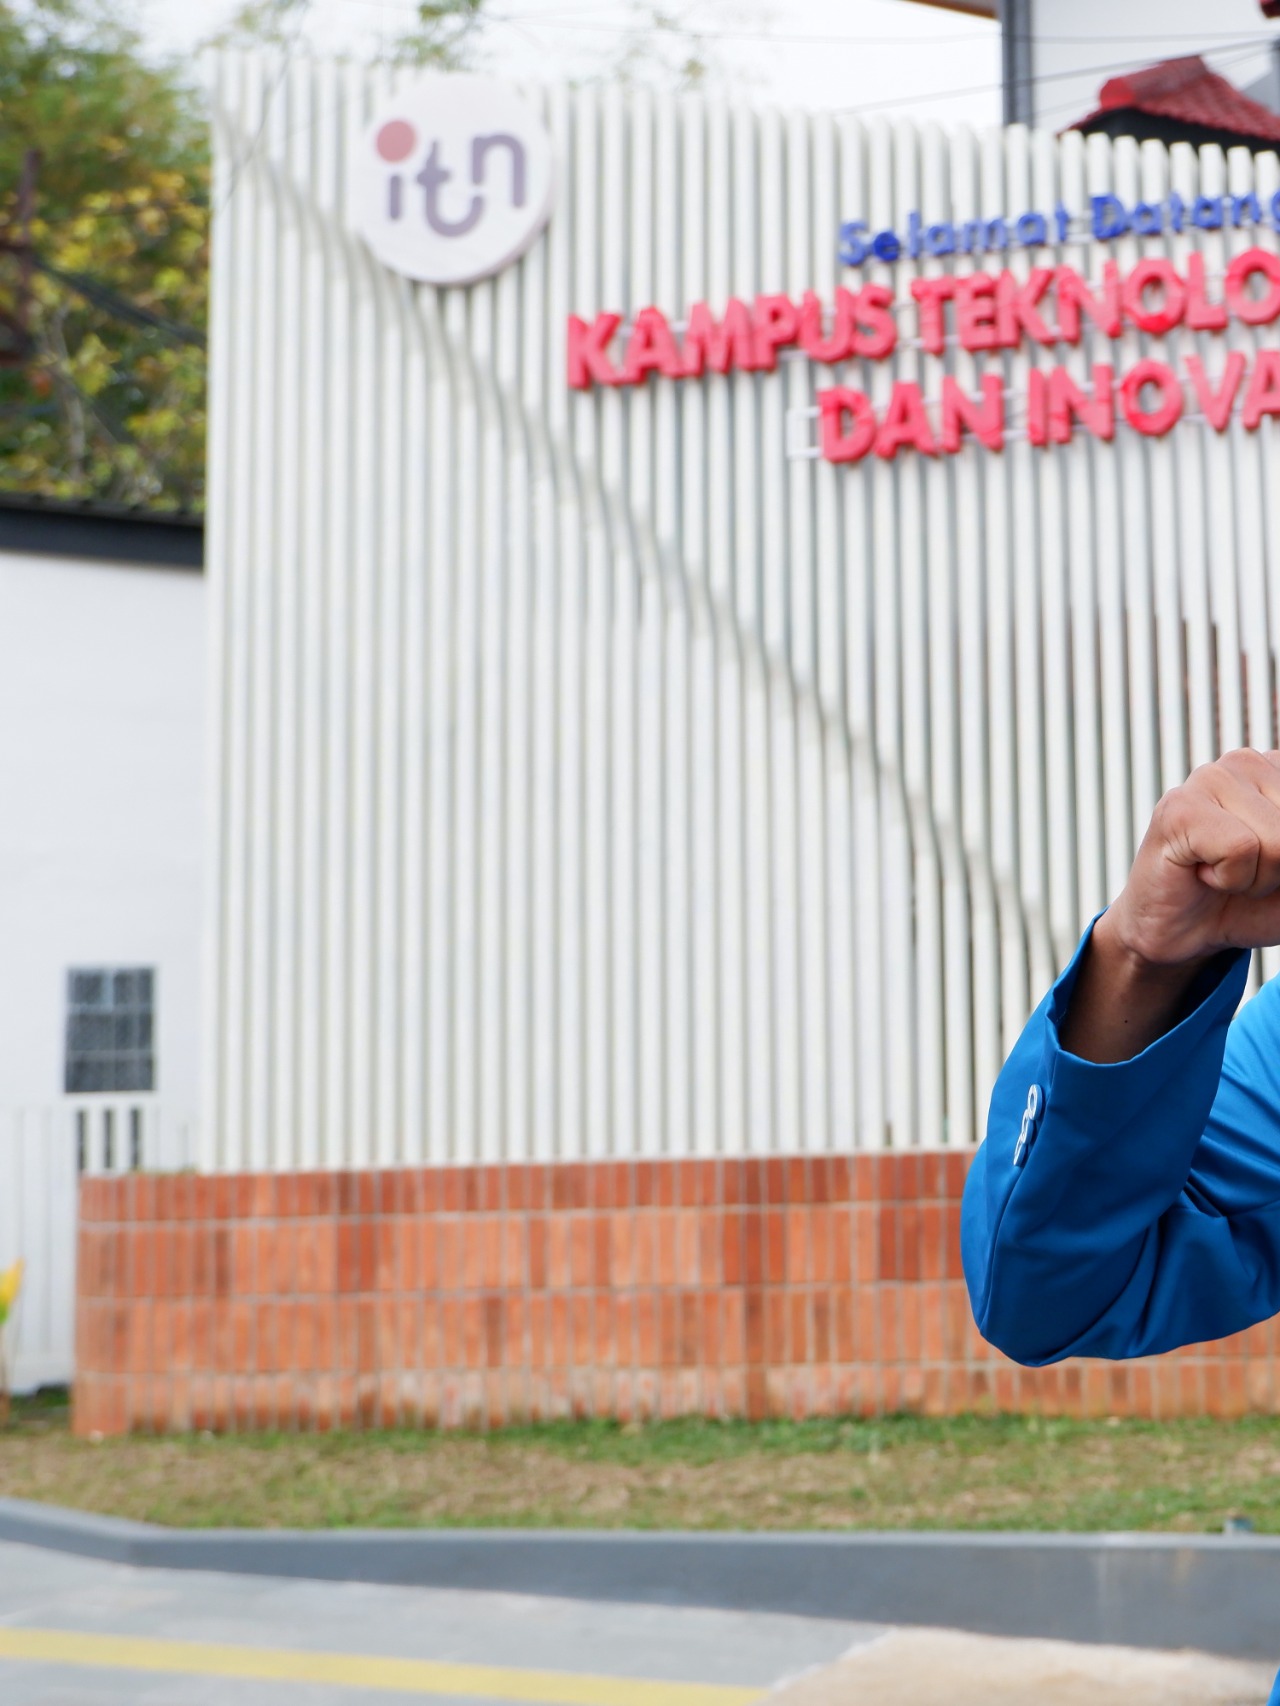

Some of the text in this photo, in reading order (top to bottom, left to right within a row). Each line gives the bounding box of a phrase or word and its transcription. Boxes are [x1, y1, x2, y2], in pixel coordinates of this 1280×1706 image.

[839, 198, 1068, 267] Selamat
[567, 282, 897, 391] KAMPUS
[816, 373, 1004, 464] DAN
